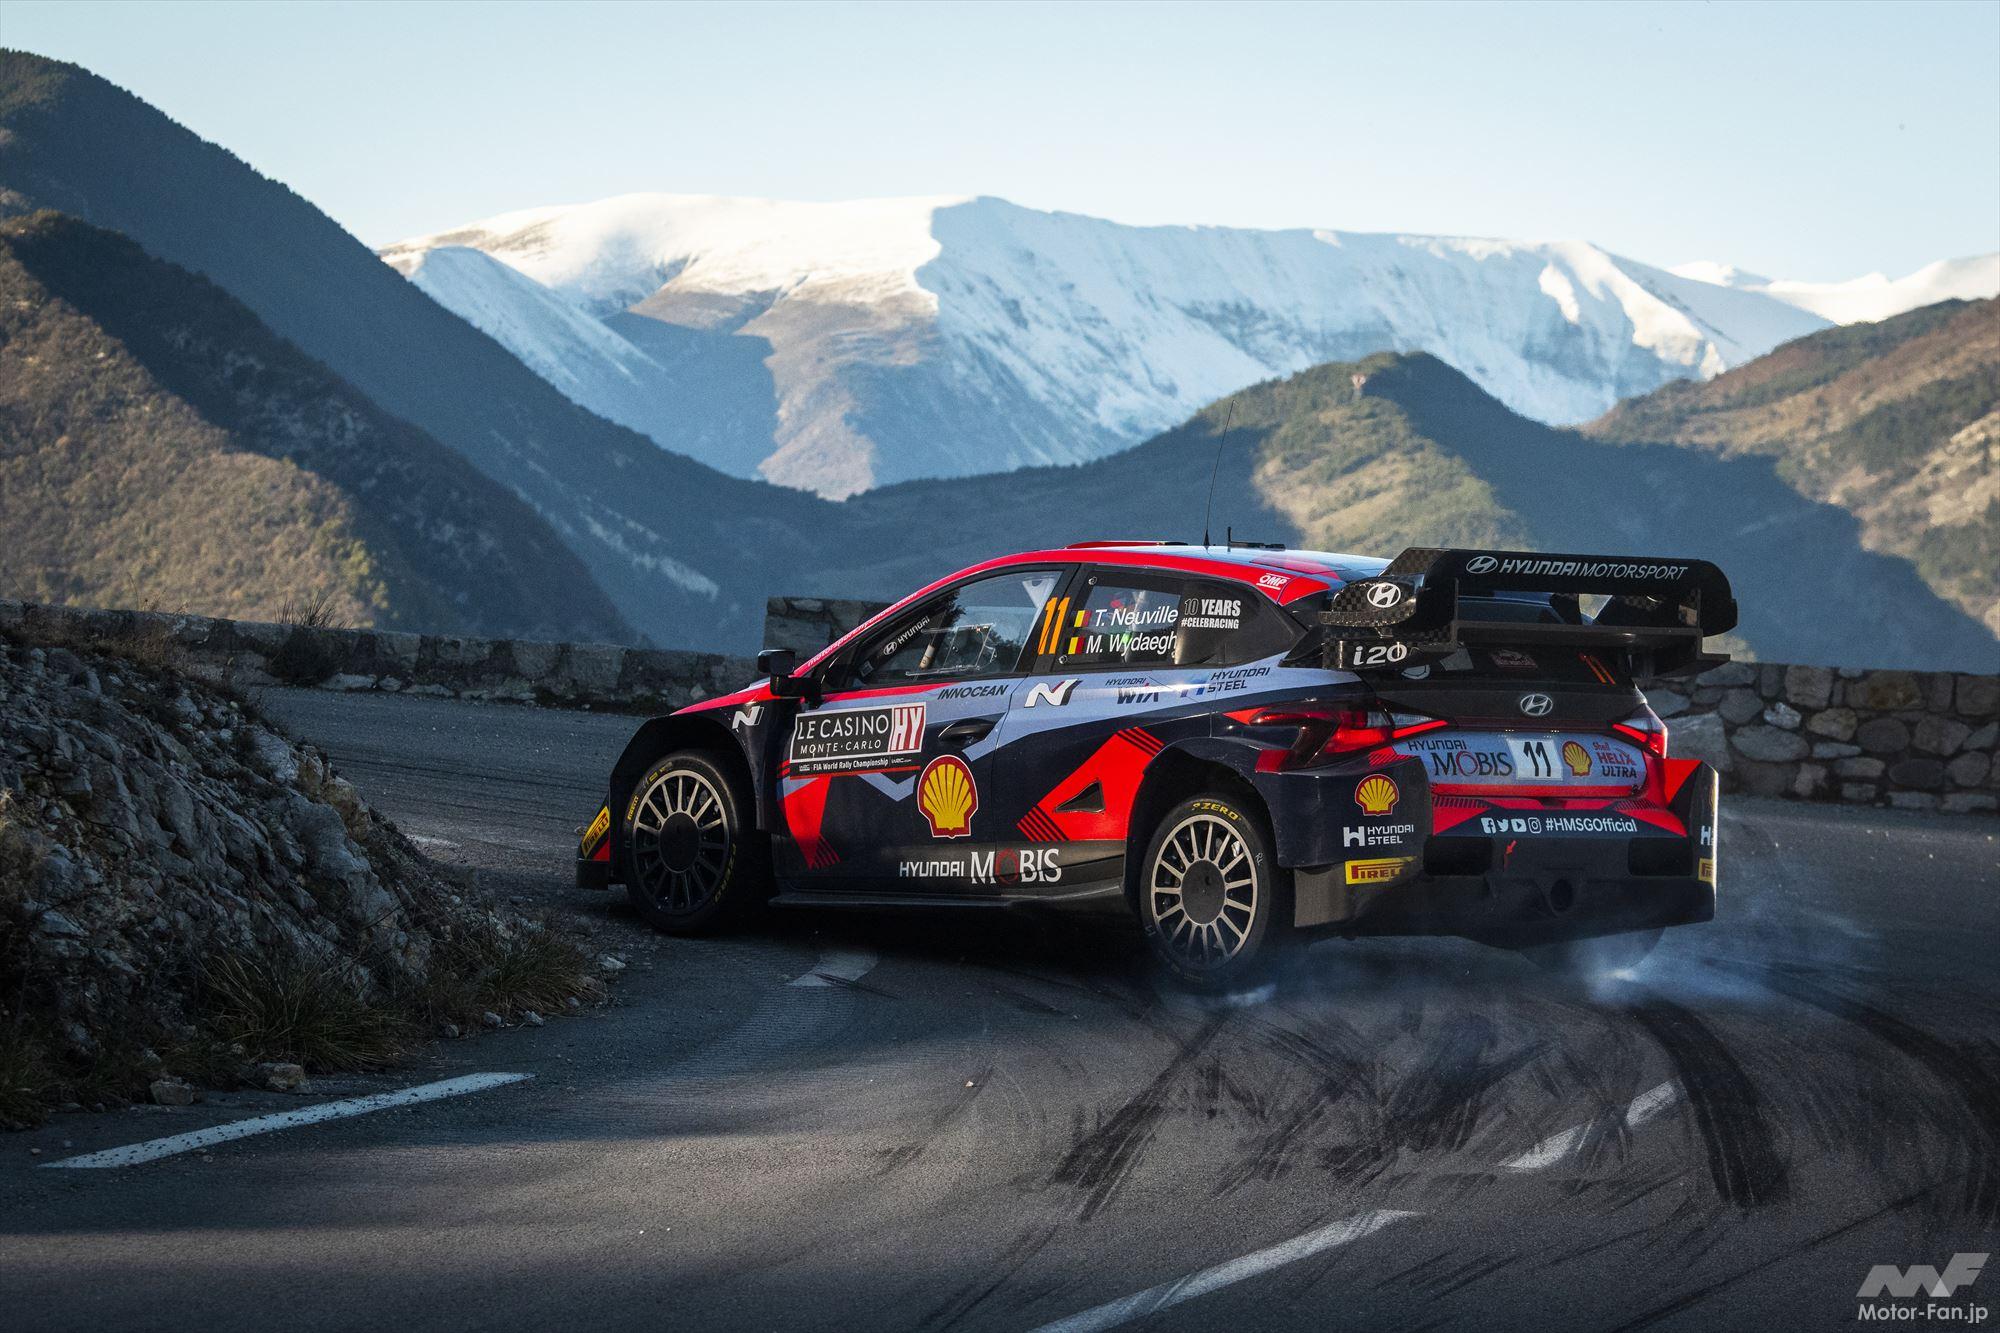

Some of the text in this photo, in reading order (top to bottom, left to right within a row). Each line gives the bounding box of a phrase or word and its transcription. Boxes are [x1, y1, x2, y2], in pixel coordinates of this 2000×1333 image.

[1258, 574, 1288, 588] OMP
[1184, 598, 1241, 617] 10 YEARS
[1095, 606, 1179, 627] T. Neuville
[1181, 617, 1240, 630] #CELEBRACING
[897, 616, 930, 645] HYUNDAI
[1038, 596, 1071, 656] 11
[1086, 635, 1103, 654] M.
[1353, 642, 1408, 666] i20
[1105, 678, 1147, 686] HYUNDAI
[1211, 667, 1271, 681] HYUNDAI
[937, 684, 1009, 701] INNOCEAN
[1207, 679, 1248, 693] STEEL
[797, 714, 889, 740] LE CASINO
[890, 707, 924, 751] HY
[1408, 739, 1467, 751] HYUNDAI
[813, 763, 822, 771] FIA
[823, 762, 838, 770] World
[839, 761, 852, 770] Rally
[853, 758, 888, 768] Championship
[1431, 750, 1513, 777] MOBIS
[1523, 741, 1552, 777] 11
[1596, 752, 1637, 766] HELIX
[1602, 765, 1637, 779] ULTRA
[1367, 824, 1414, 835] HYUNDAI
[1546, 816, 1638, 833] #HMSGOfficial
[1367, 835, 1403, 846] STEEL
[899, 861, 965, 877] HYUNDAI
[970, 848, 1062, 885] MOBIS
[1351, 862, 1406, 880] PIREL
